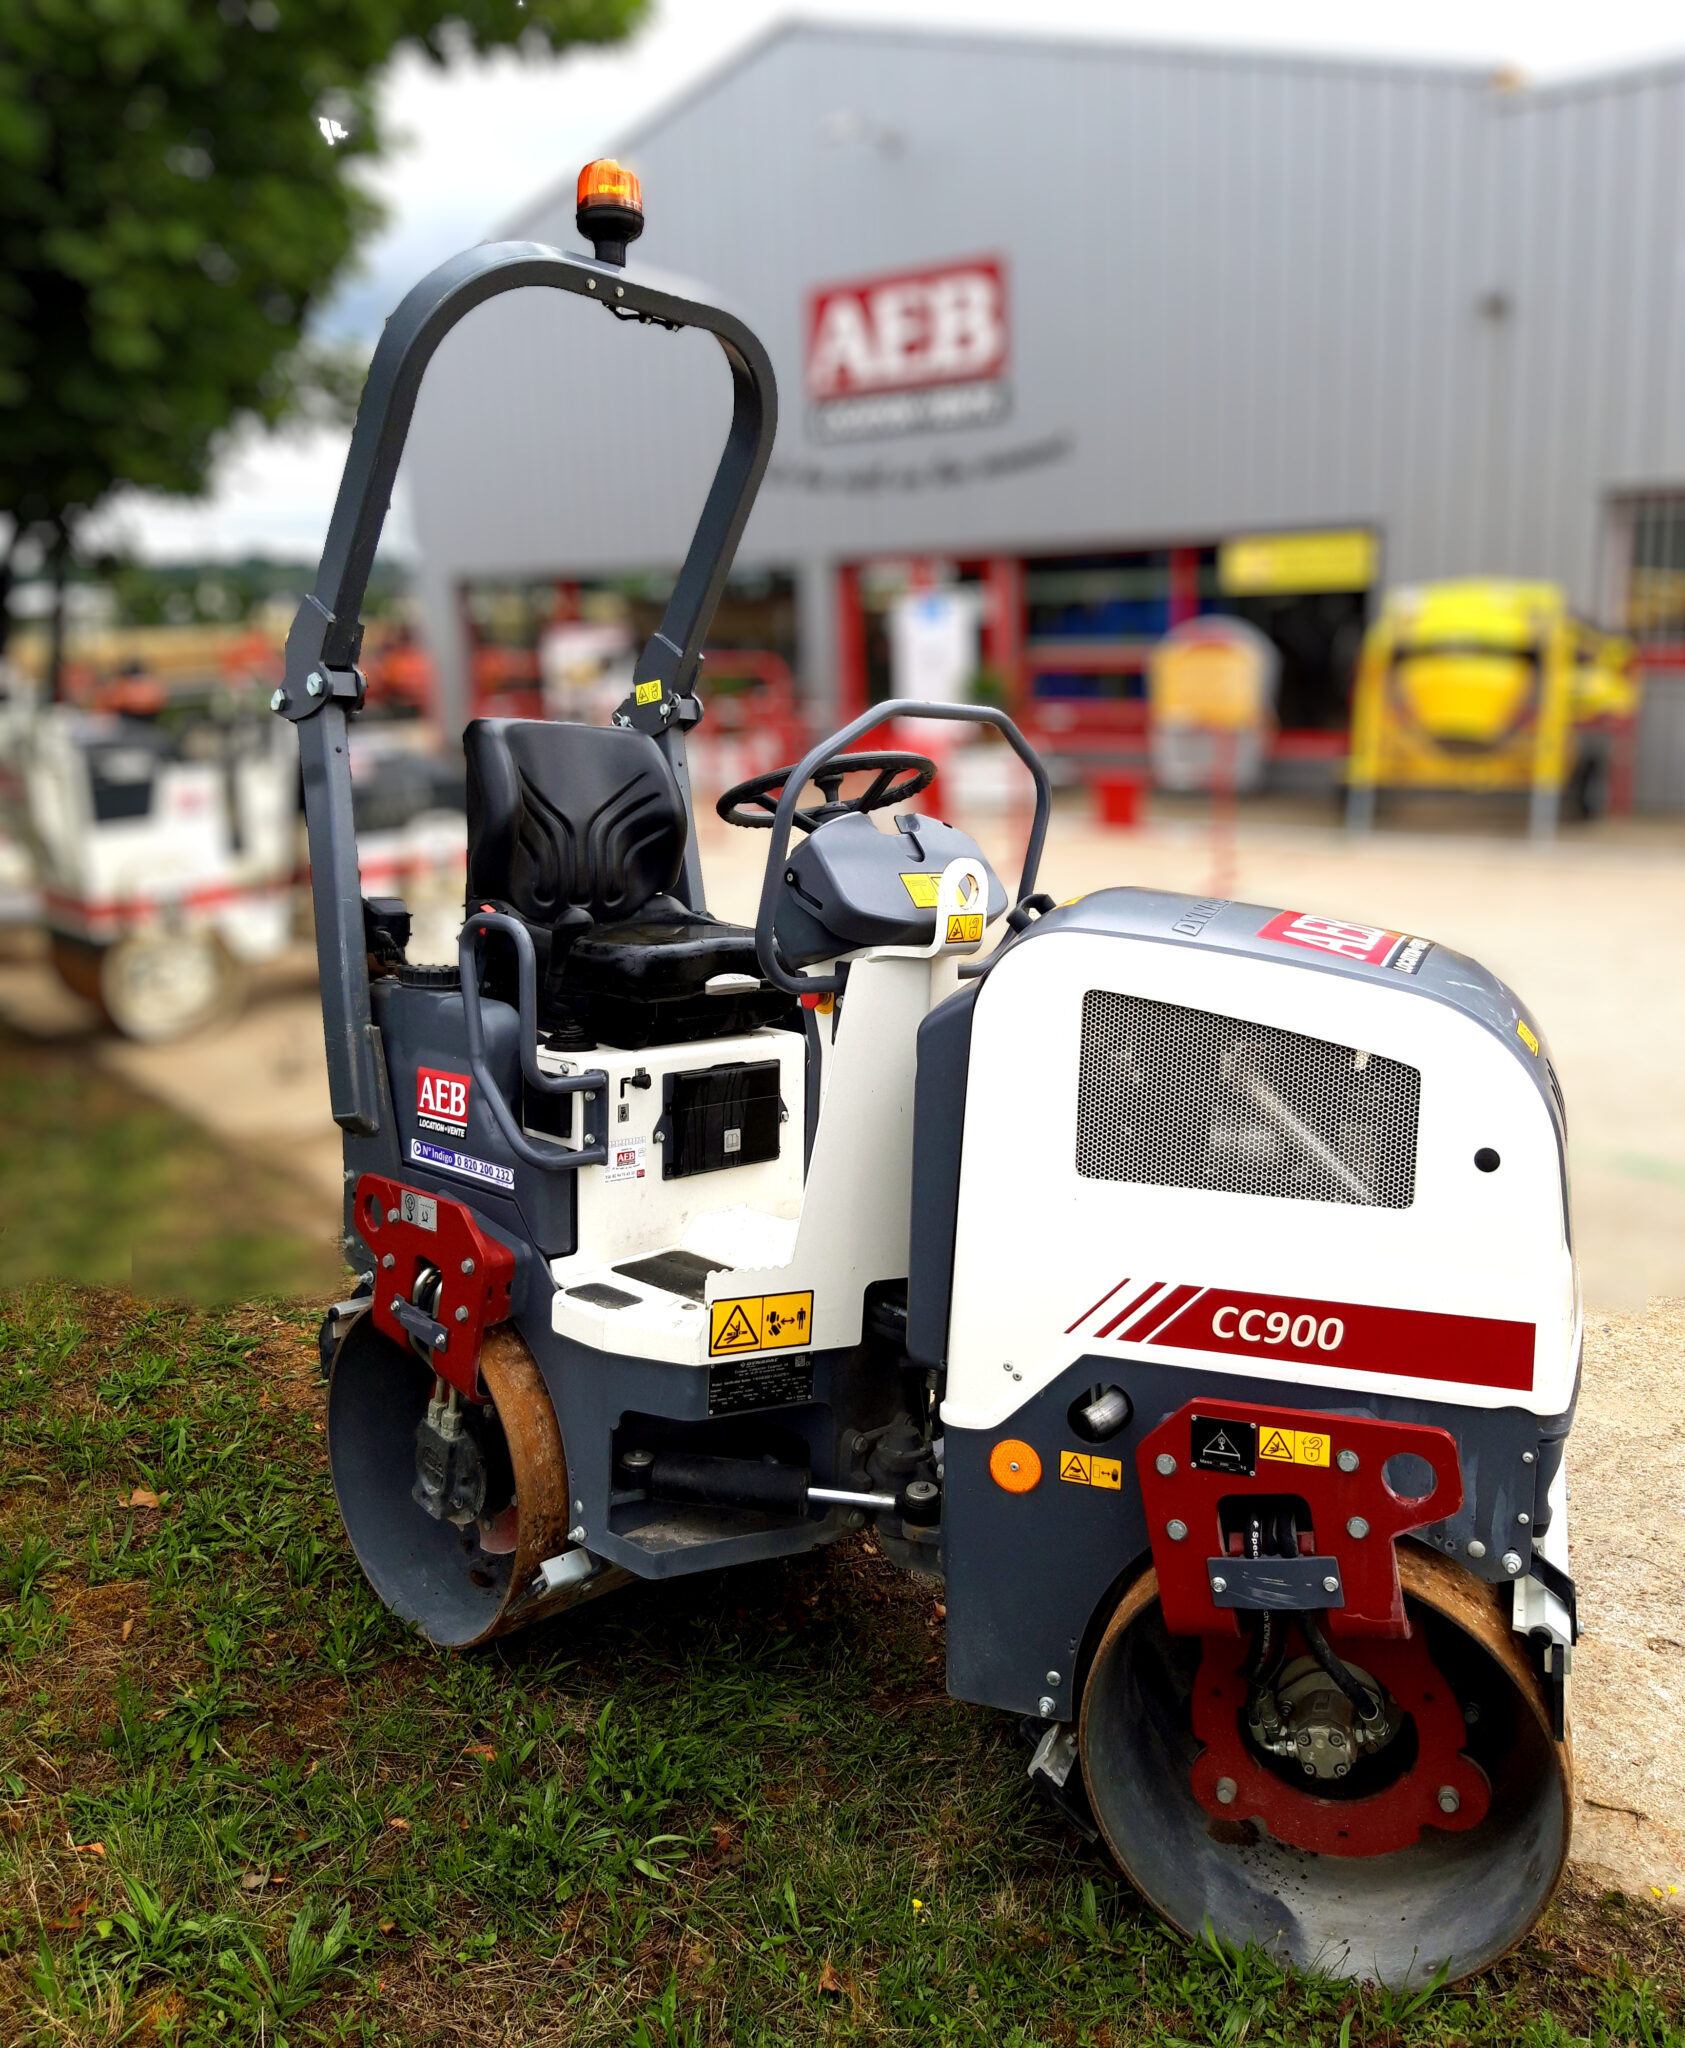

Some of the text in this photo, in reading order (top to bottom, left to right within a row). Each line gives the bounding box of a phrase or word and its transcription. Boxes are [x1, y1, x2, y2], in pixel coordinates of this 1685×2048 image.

[809, 272, 1003, 393] AEB
[419, 1076, 466, 1117] AEB
[432, 1147, 452, 1164] Indigo
[457, 1156, 462, 1166] 0
[464, 1158, 477, 1171] 820
[480, 1163, 494, 1176] 200
[496, 1168, 510, 1181] 232
[1211, 1306, 1344, 1351] CC900
